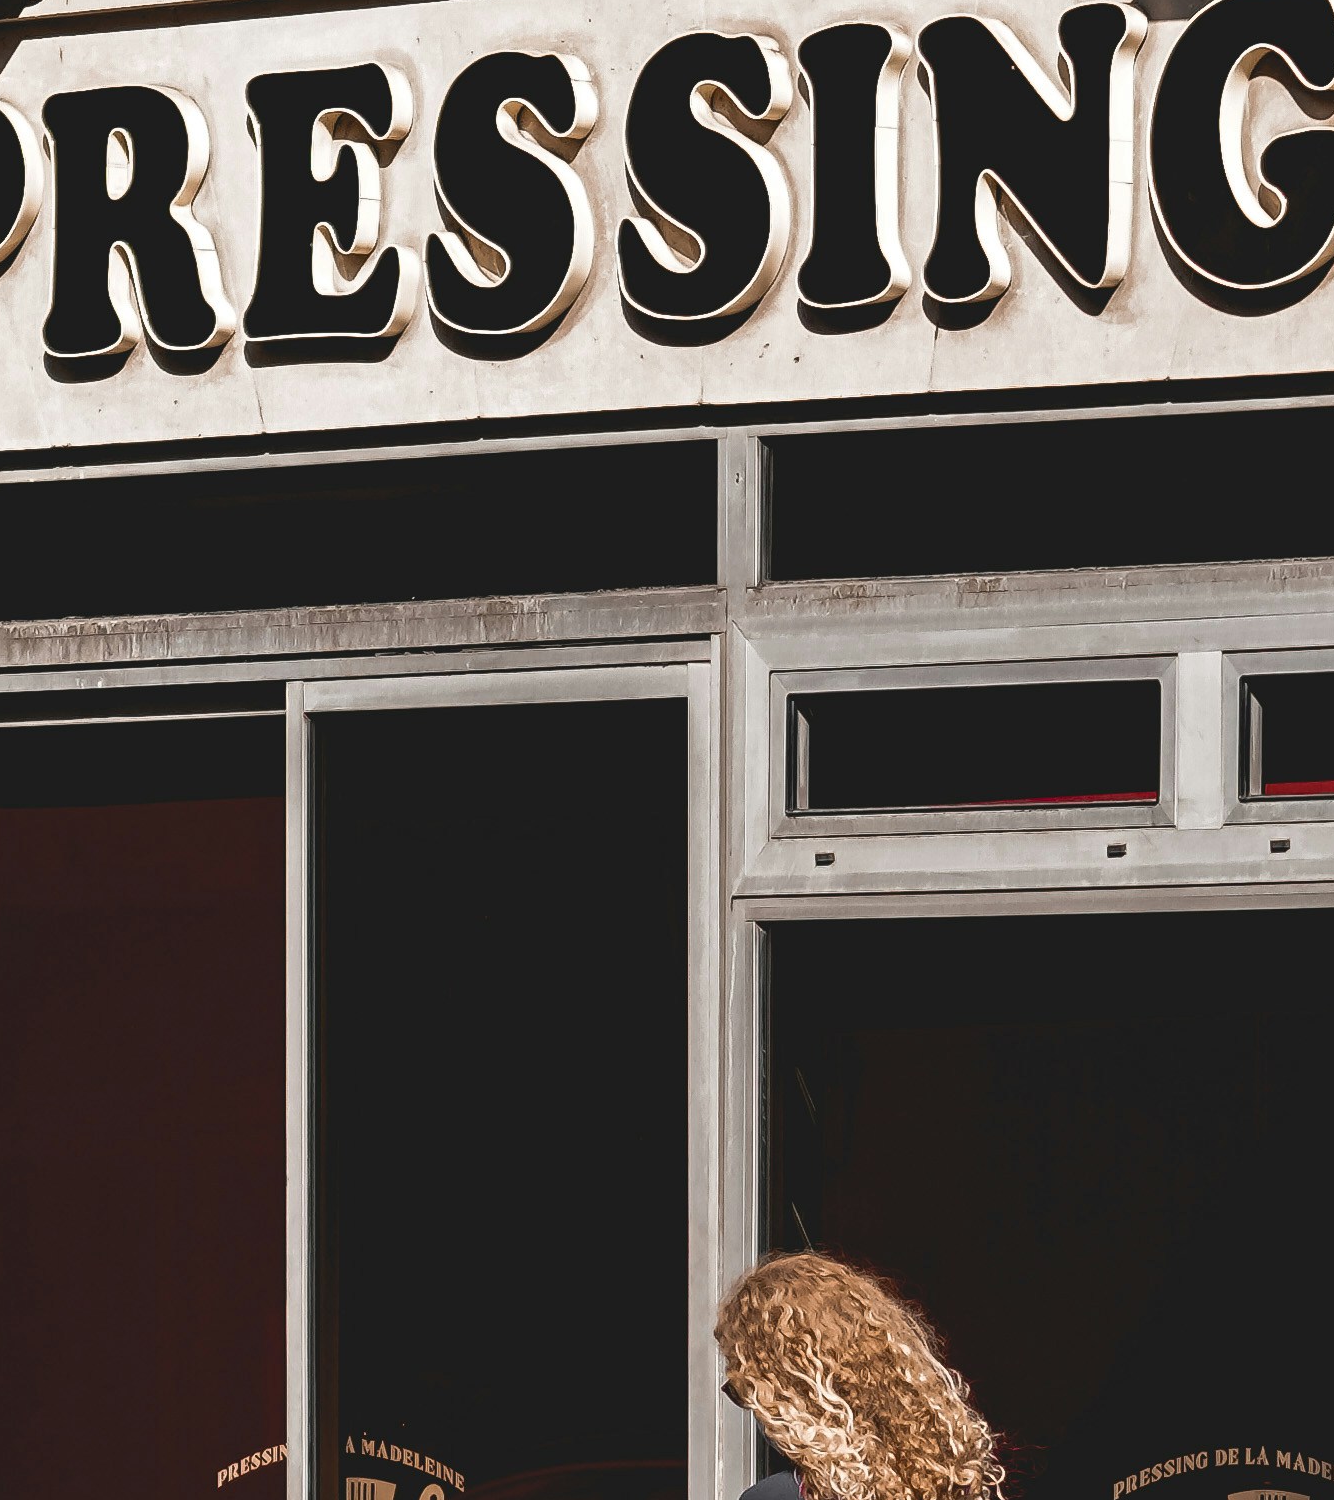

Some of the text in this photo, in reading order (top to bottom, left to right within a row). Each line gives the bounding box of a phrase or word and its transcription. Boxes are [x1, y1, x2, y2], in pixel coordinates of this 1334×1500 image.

[217, 1442, 288, 1488] PRESSIN
[361, 1438, 465, 1493] MADELEINE
[1113, 1451, 1208, 1500] PRESSING
[1215, 1448, 1239, 1467] DE
[1245, 1446, 1270, 1466] LA
